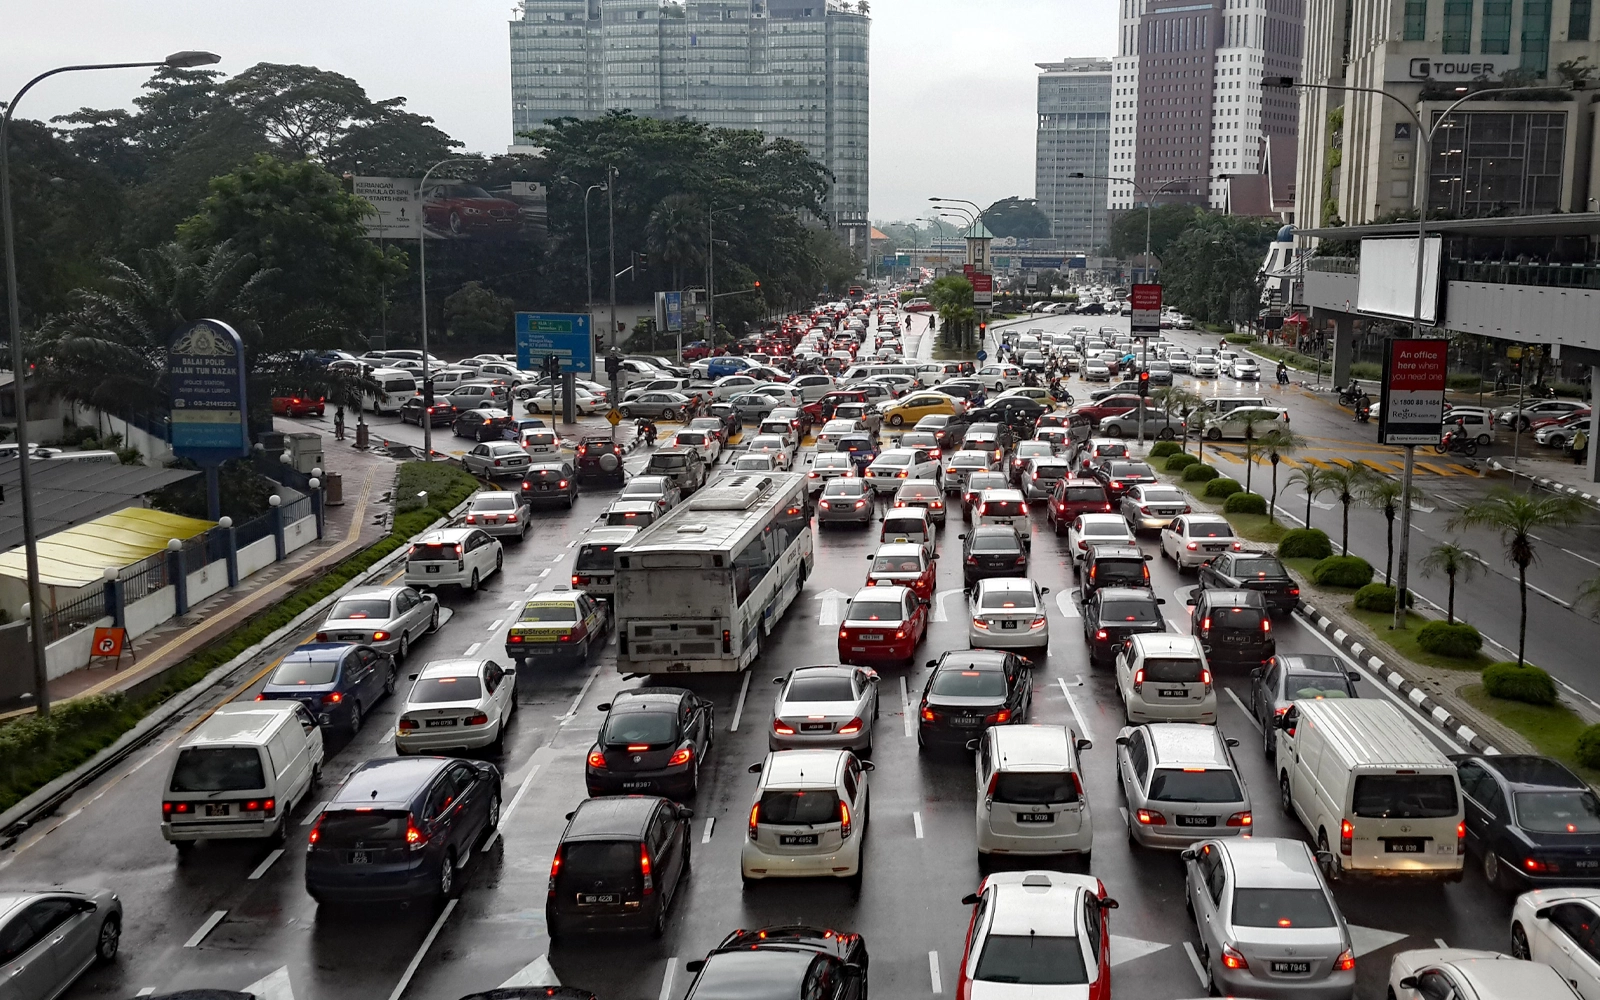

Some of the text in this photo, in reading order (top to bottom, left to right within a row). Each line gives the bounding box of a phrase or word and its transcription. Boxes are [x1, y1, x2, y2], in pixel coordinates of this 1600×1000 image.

[1434, 63, 1494, 73] TOWER
[1400, 350, 1438, 359] An office
[1418, 362, 1438, 370] when
[1408, 372, 1426, 380] need
[1275, 963, 1288, 971] WWR
